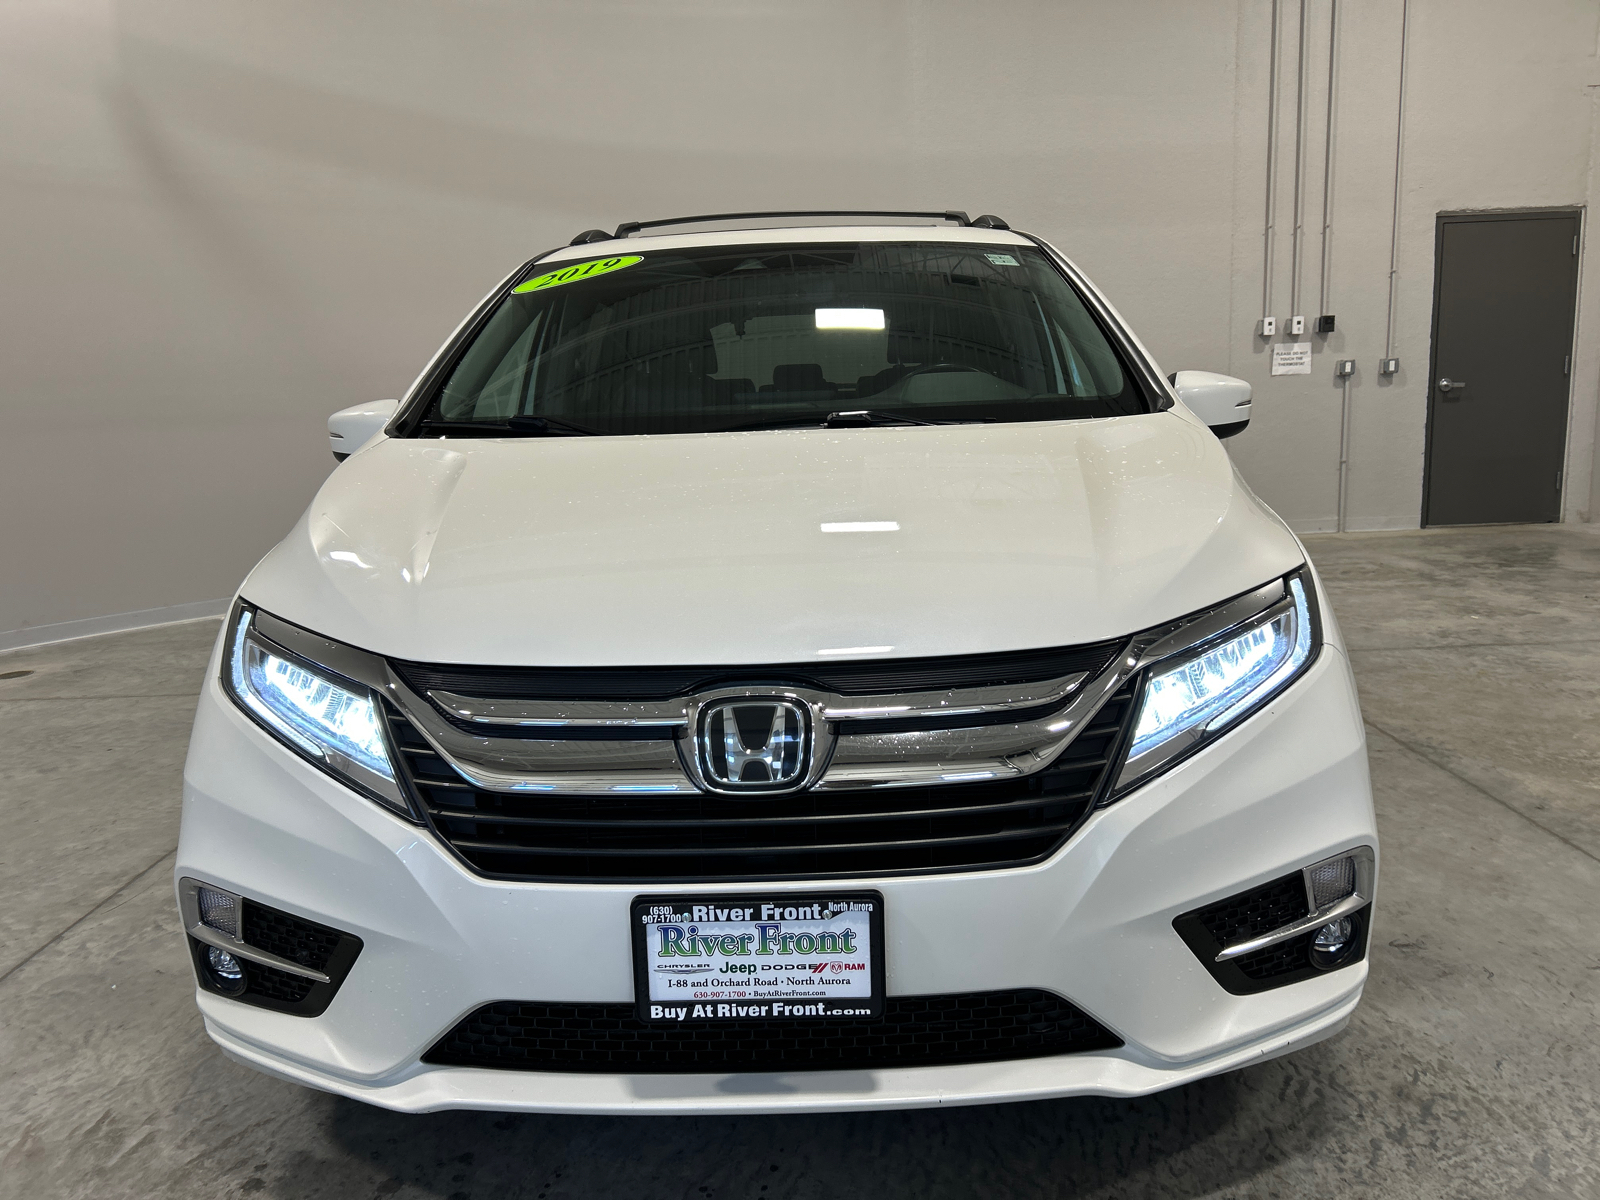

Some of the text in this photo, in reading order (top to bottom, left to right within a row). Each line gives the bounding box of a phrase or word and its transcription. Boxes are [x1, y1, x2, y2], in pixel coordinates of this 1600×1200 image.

[533, 257, 622, 290] 2019
[649, 905, 673, 915] (630)
[828, 901, 874, 912] North Aurora
[692, 903, 822, 922] River Front
[641, 914, 681, 924] 907-1700
[657, 922, 858, 957] River Front
[719, 961, 758, 975] Jeep
[761, 963, 819, 971] DODGE
[844, 963, 866, 971] RAM
[667, 976, 852, 988] I-88 and Orchard Road North Aurora
[693, 989, 827, 999] 630-907-1700 BuyAtRiverFront.com
[650, 1004, 687, 1021] Buy
[692, 1003, 714, 1018] At
[717, 1002, 769, 1017] River
